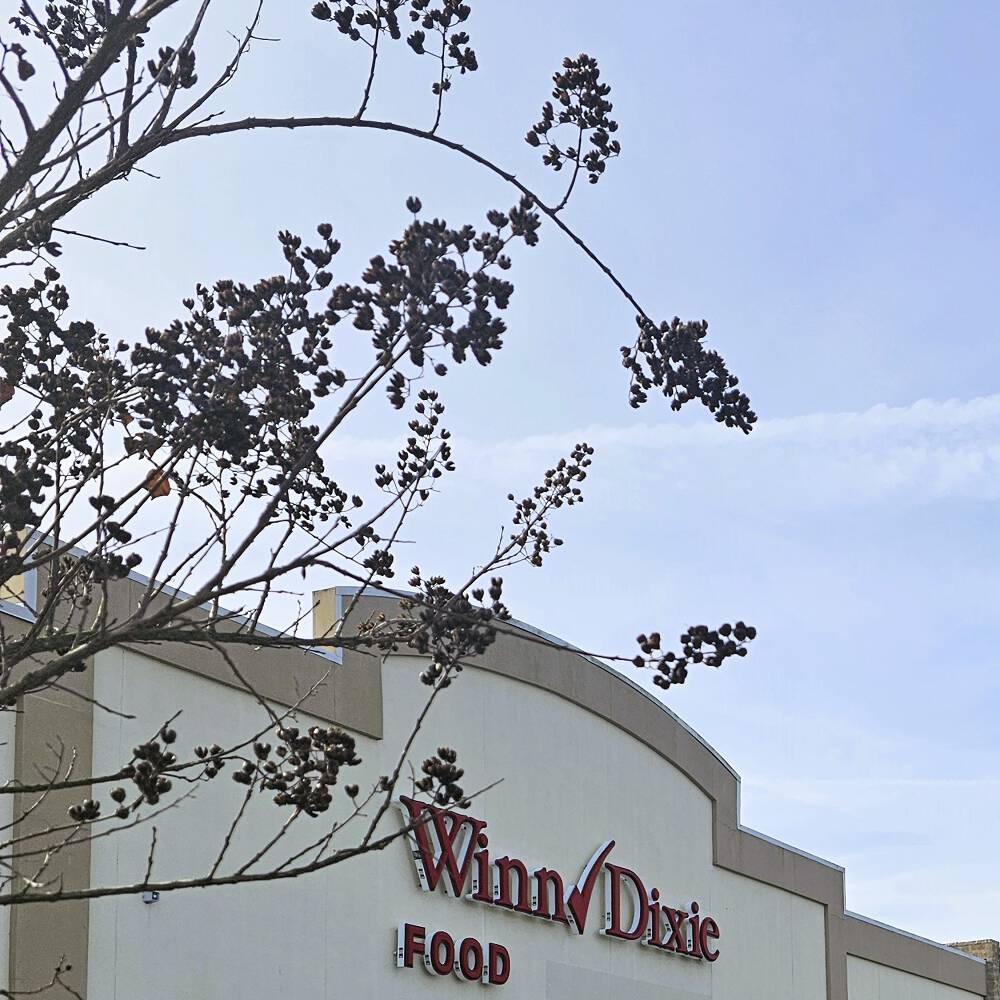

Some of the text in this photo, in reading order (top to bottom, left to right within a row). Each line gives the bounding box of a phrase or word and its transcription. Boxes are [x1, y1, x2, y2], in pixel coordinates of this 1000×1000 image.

[399, 795, 720, 962] Winn Dixie
[396, 922, 511, 985] FOOD
